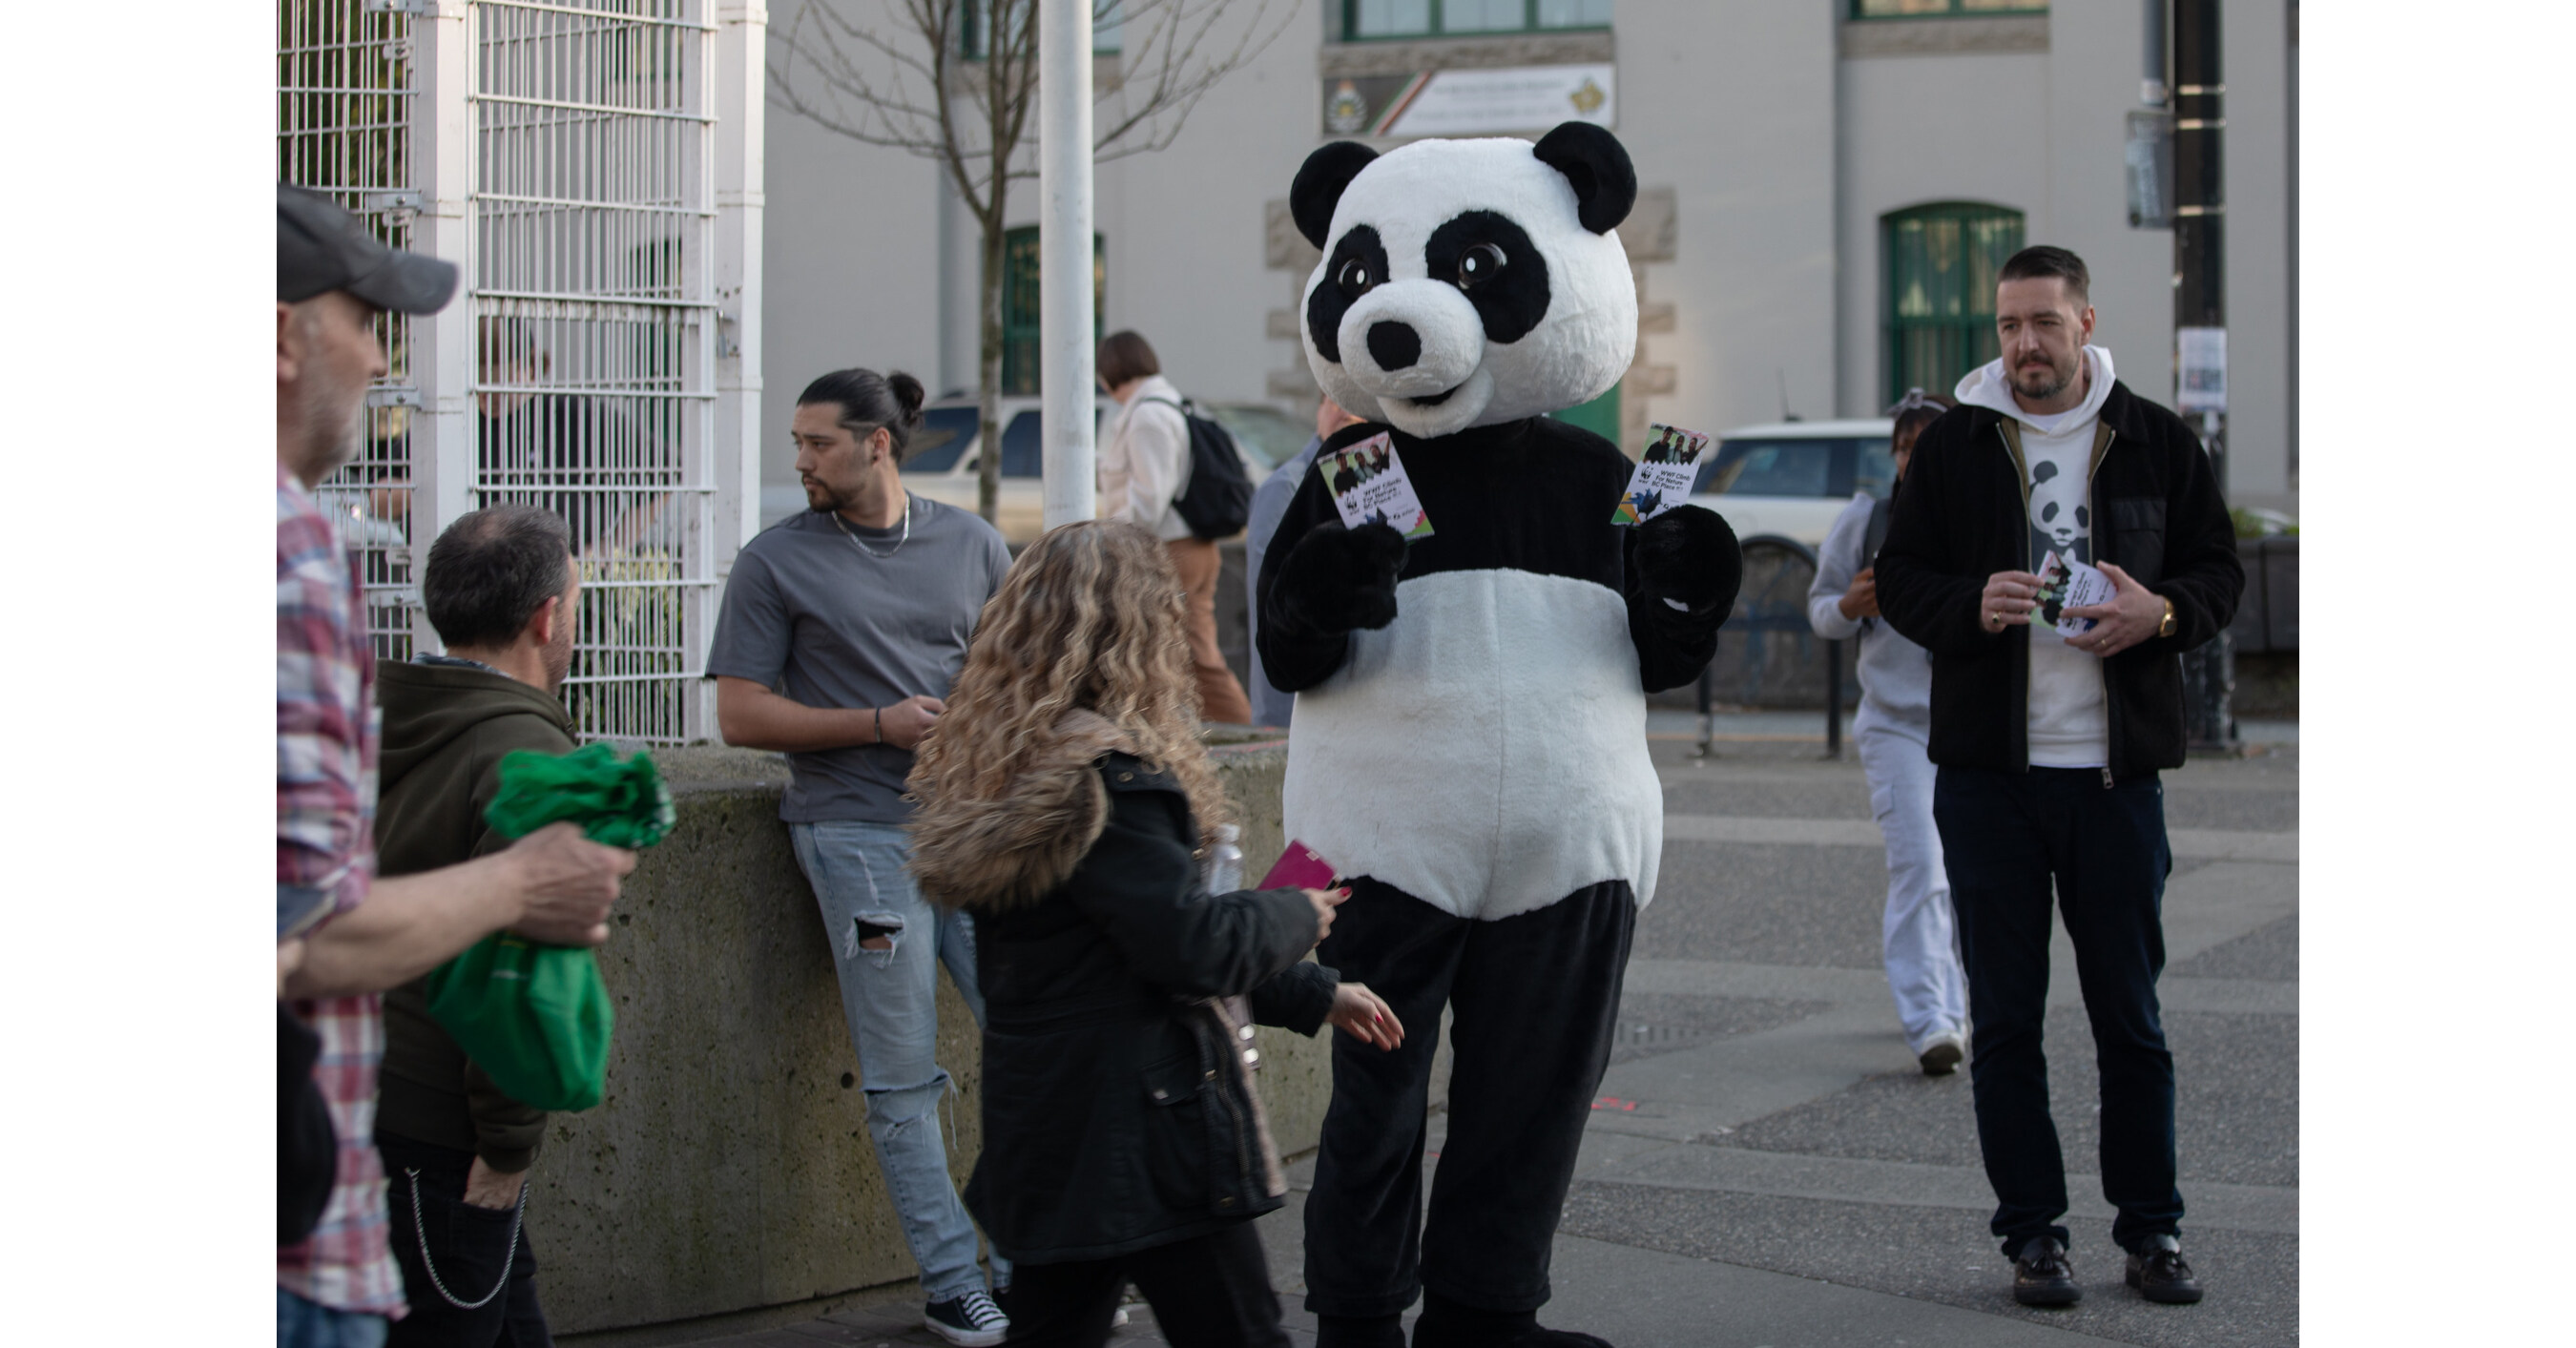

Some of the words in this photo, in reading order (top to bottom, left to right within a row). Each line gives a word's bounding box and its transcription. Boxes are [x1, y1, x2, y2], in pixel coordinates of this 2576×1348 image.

[1660, 469, 1676, 478] WWF
[1676, 473, 1691, 482] Climb
[1660, 482, 1676, 490] Place
[1665, 477, 1683, 486] Nature
